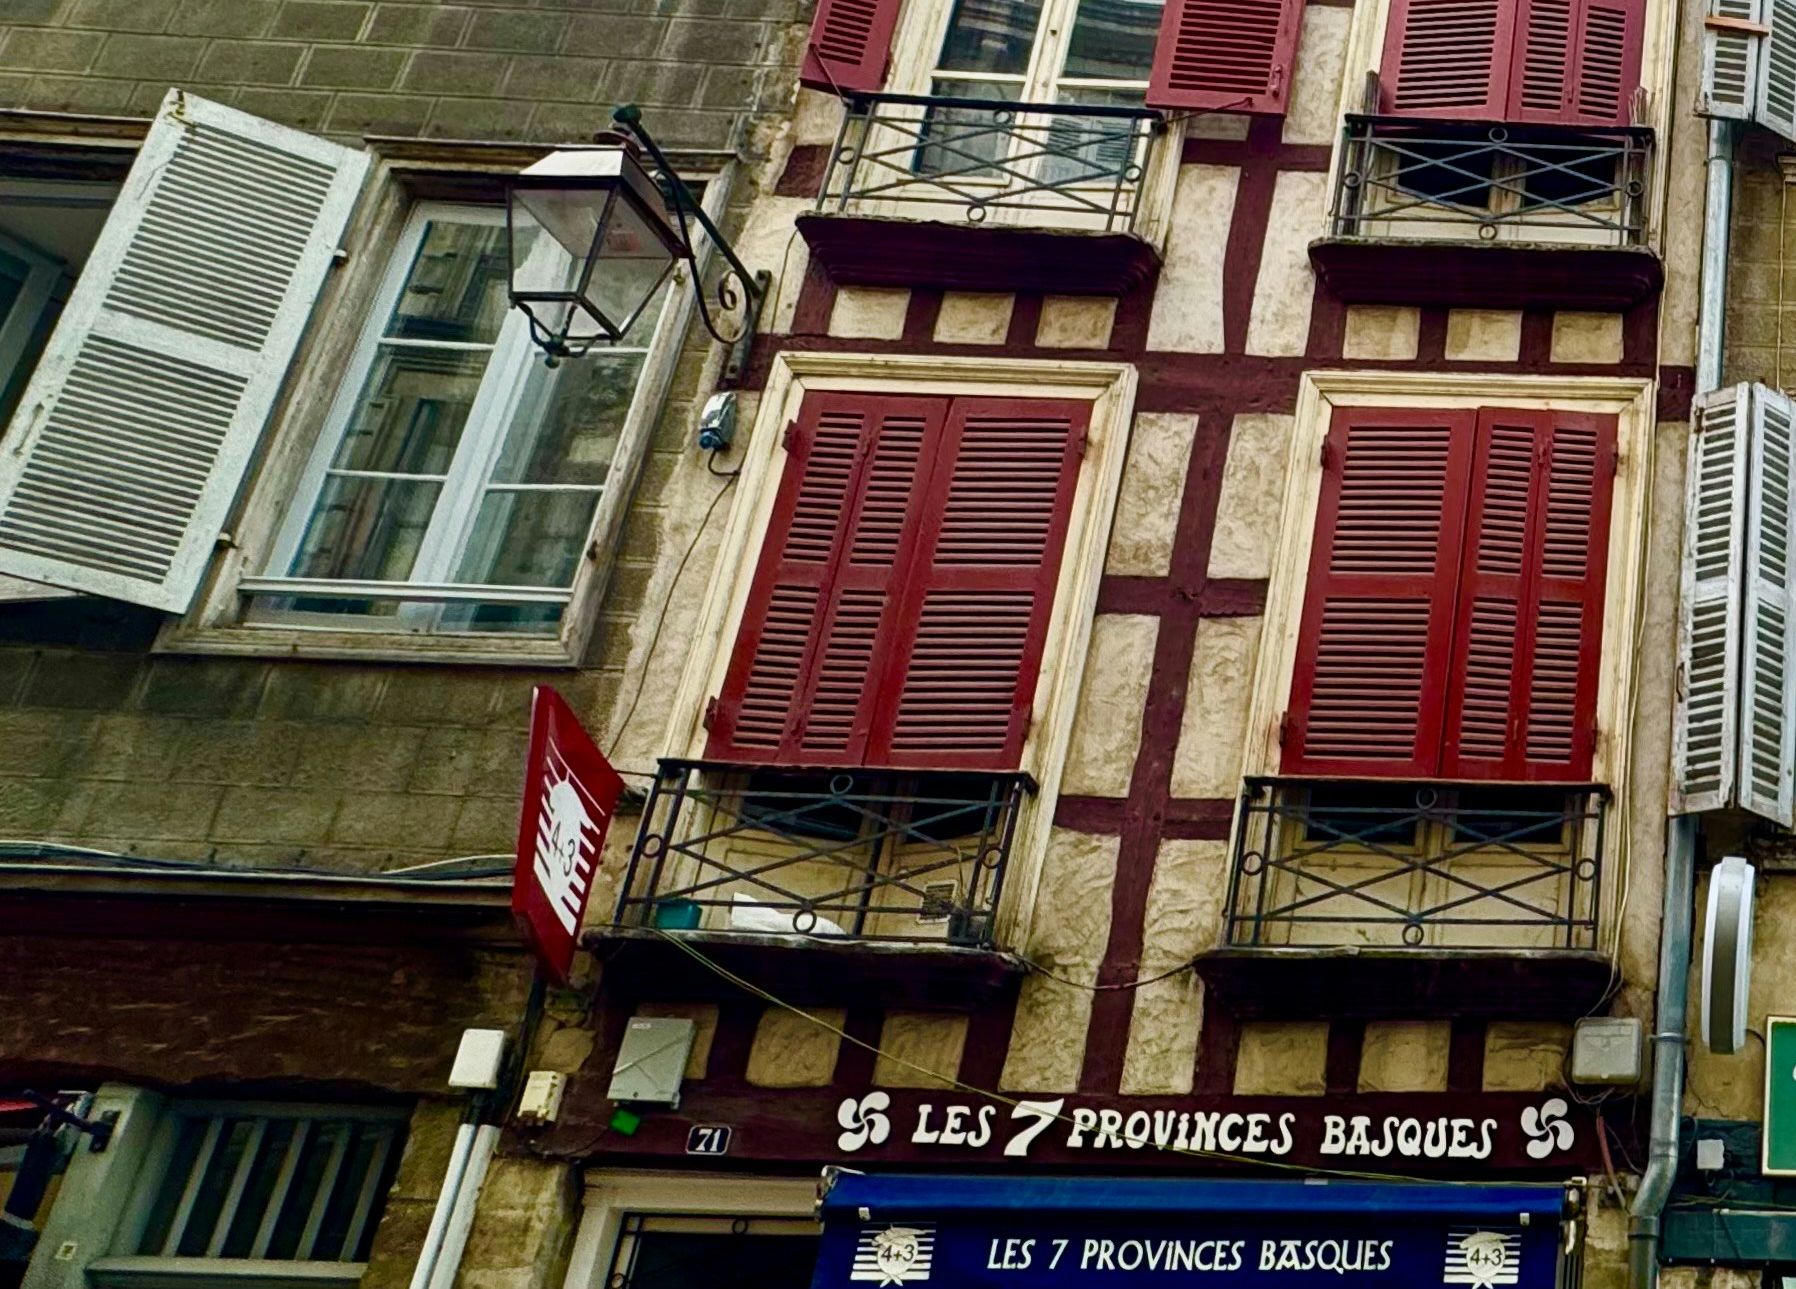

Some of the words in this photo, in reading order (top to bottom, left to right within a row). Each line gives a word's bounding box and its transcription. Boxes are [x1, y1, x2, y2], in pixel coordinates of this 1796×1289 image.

[695, 1129, 721, 1152] 71
[911, 1104, 997, 1148] LES
[1003, 1098, 1065, 1156] 7
[1319, 1115, 1498, 1160] BASQUES
[881, 1243, 915, 1263] 4+3
[986, 1238, 1036, 1270] LES
[1048, 1238, 1069, 1270] 7
[1258, 1239, 1394, 1275] BASQUES
[1469, 1250, 1503, 1266] 4+3
